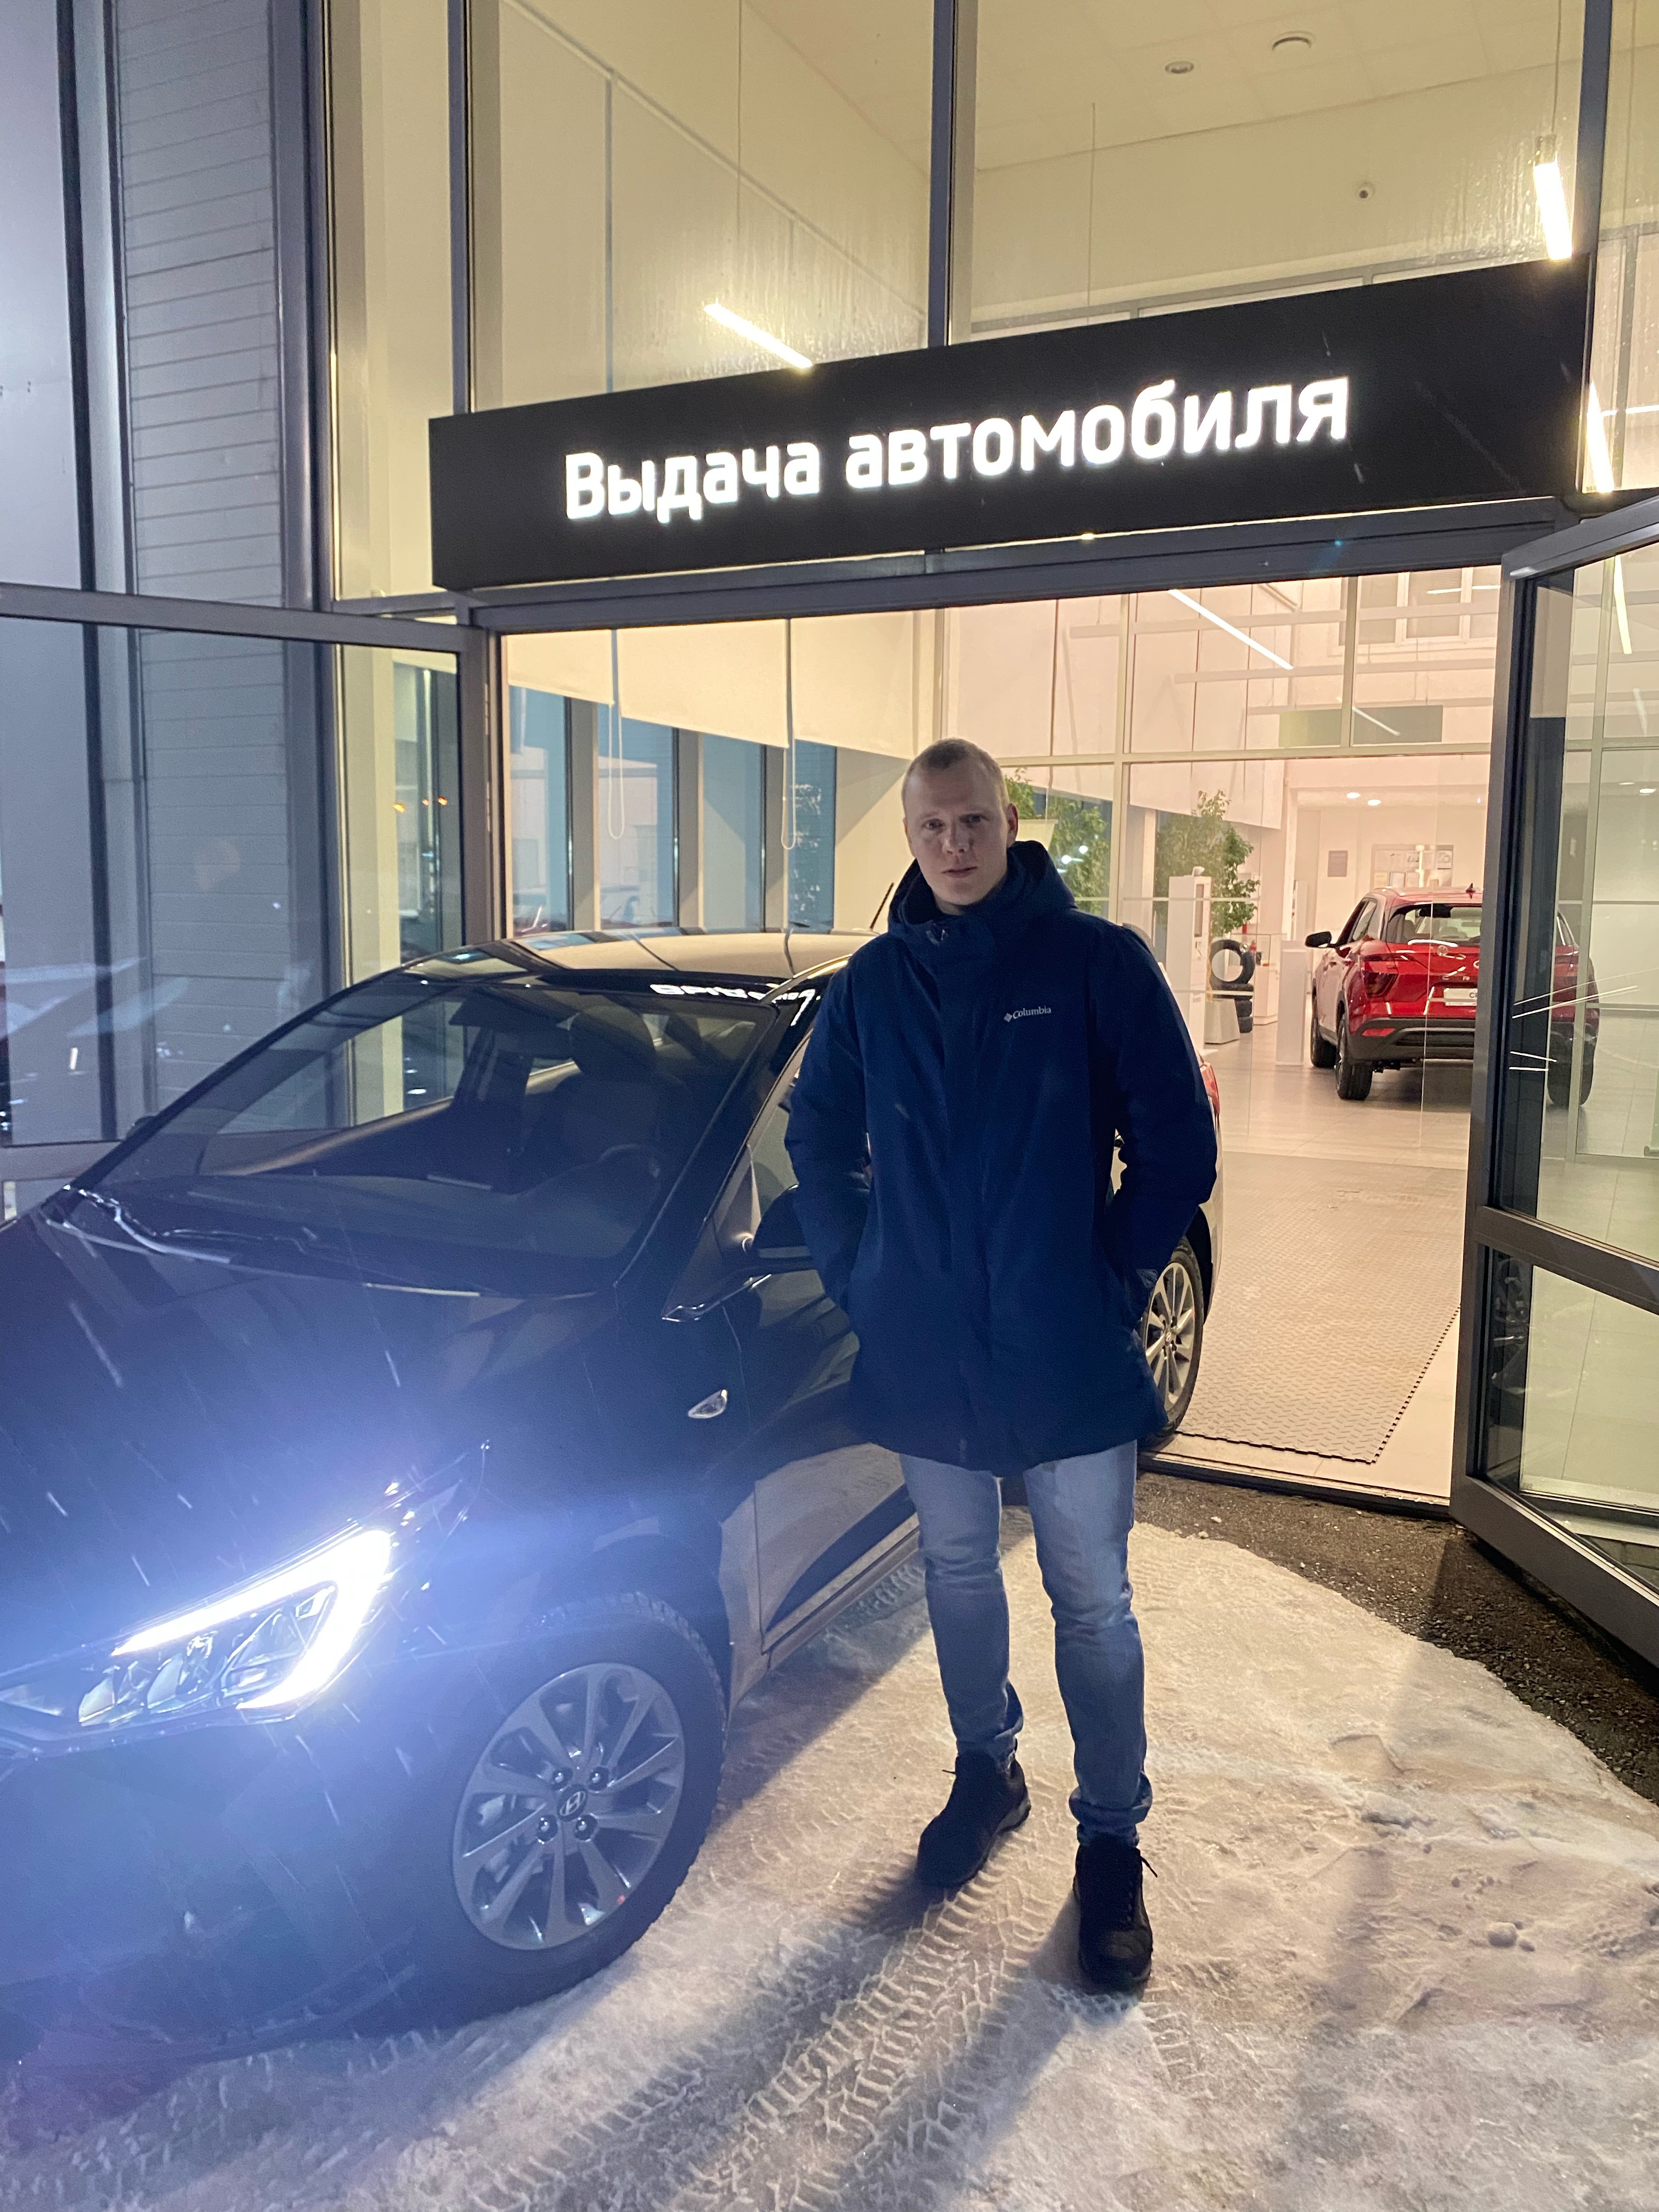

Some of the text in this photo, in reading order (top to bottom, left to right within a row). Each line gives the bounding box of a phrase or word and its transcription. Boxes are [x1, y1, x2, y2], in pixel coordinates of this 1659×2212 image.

[565, 376, 1349, 524] Выдача автомобиля
[1013, 1006, 1052, 1019] Columbia
